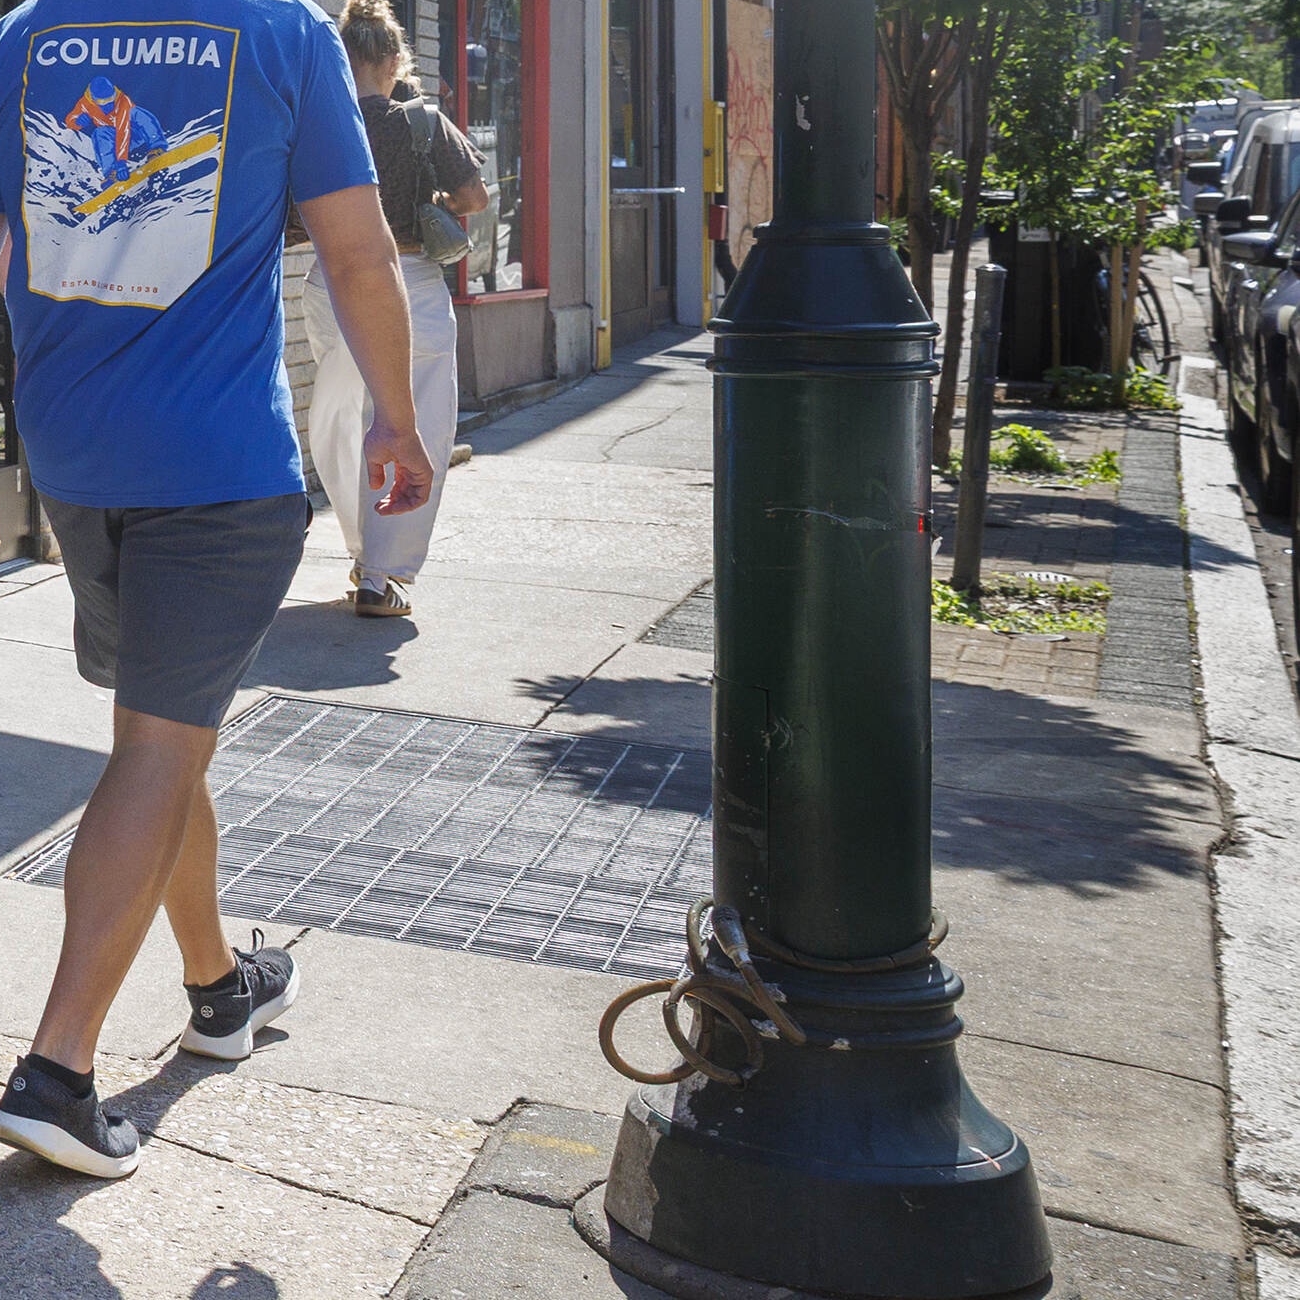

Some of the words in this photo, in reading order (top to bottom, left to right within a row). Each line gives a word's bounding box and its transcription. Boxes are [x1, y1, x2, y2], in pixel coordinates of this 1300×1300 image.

[36, 37, 221, 68] COLUMBIA
[61, 280, 123, 292] ESTABHED
[131, 285, 158, 294] 1938
